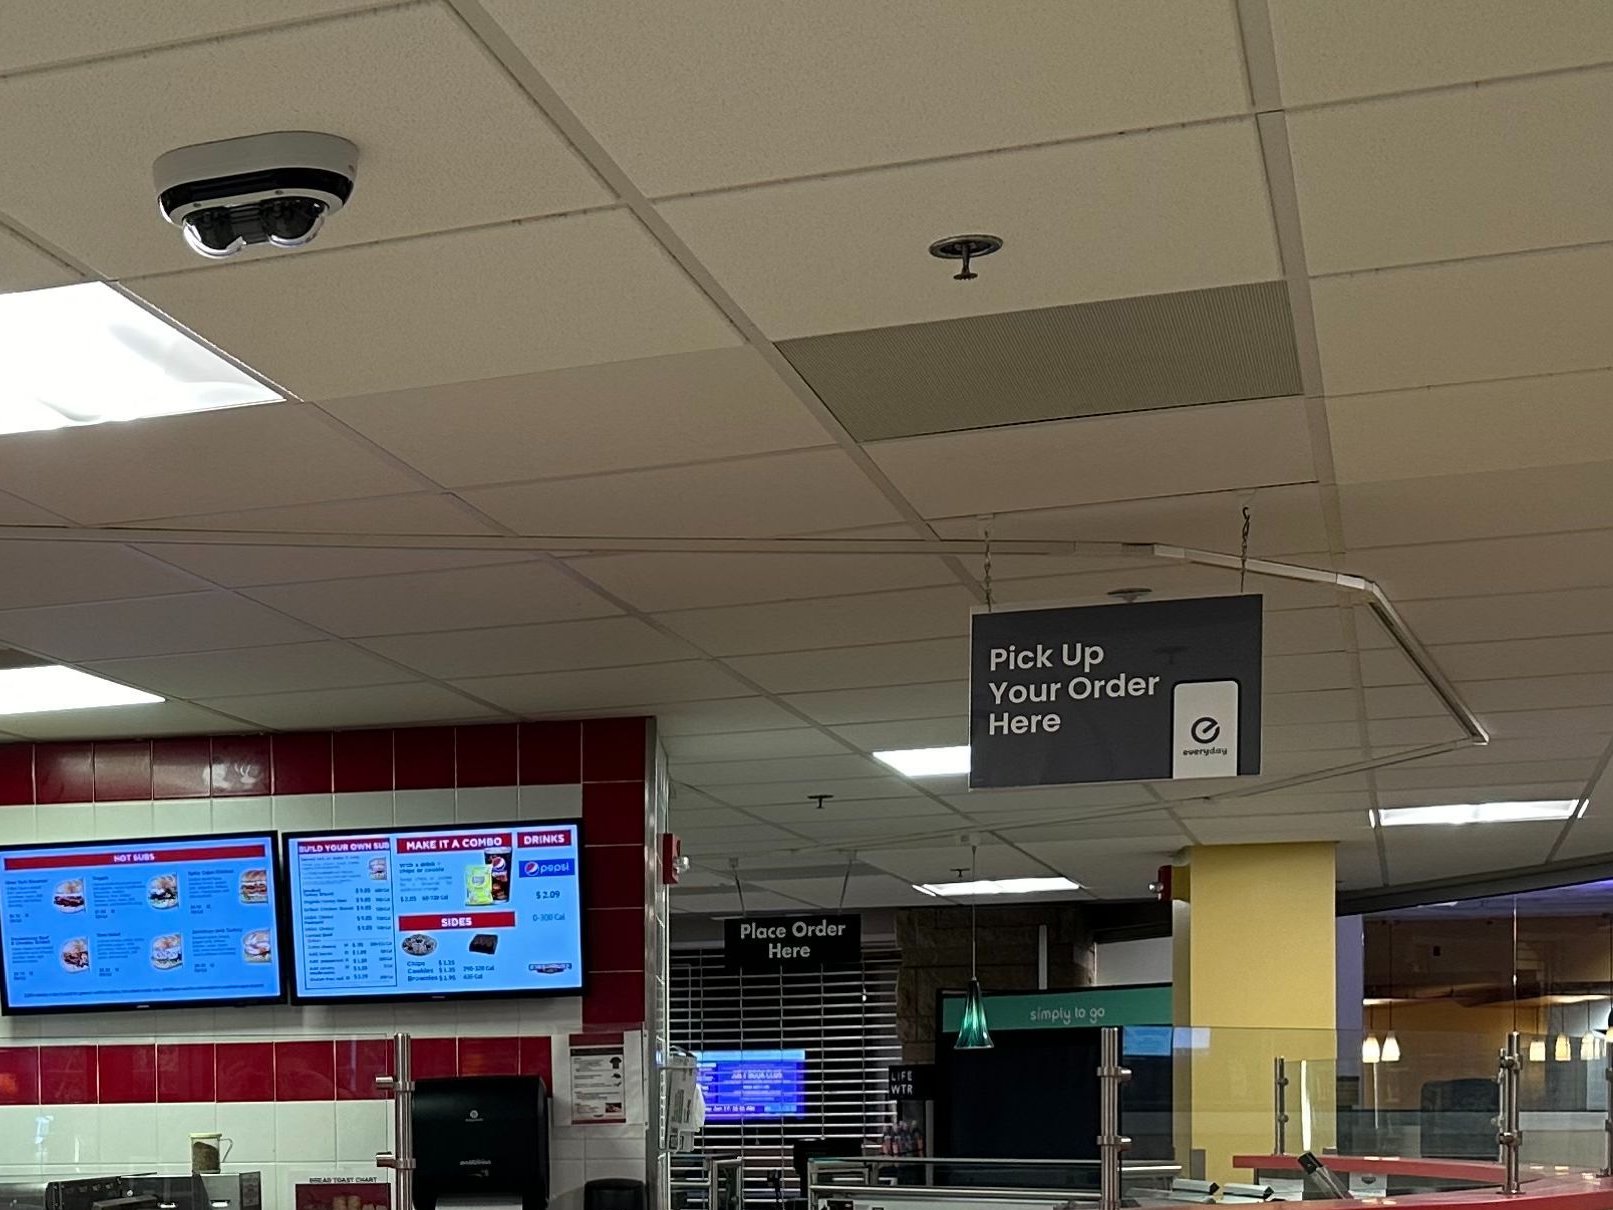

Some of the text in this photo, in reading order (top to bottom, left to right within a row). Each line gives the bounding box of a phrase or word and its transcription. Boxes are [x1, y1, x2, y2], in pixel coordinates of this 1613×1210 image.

[989, 642, 1105, 673] Pick Up
[989, 673, 1161, 705] Your Order
[988, 711, 1062, 736] Here
[1182, 746, 1228, 757] everyday
[406, 837, 502, 850] MAKE IT A COMBO
[523, 834, 565, 845] DRINKS
[298, 842, 390, 853] BUILD YOUR OWN SUB
[113, 853, 155, 863] HOT SUBS
[540, 862, 570, 874] pepsi
[542, 890, 560, 899] 2.09
[440, 917, 473, 927] SIDES
[740, 918, 846, 940] Place Order
[768, 942, 811, 959] Here
[1030, 1005, 1106, 1024] simply to go
[891, 1071, 913, 1082] LIFE
[891, 1083, 913, 1095] WTR
